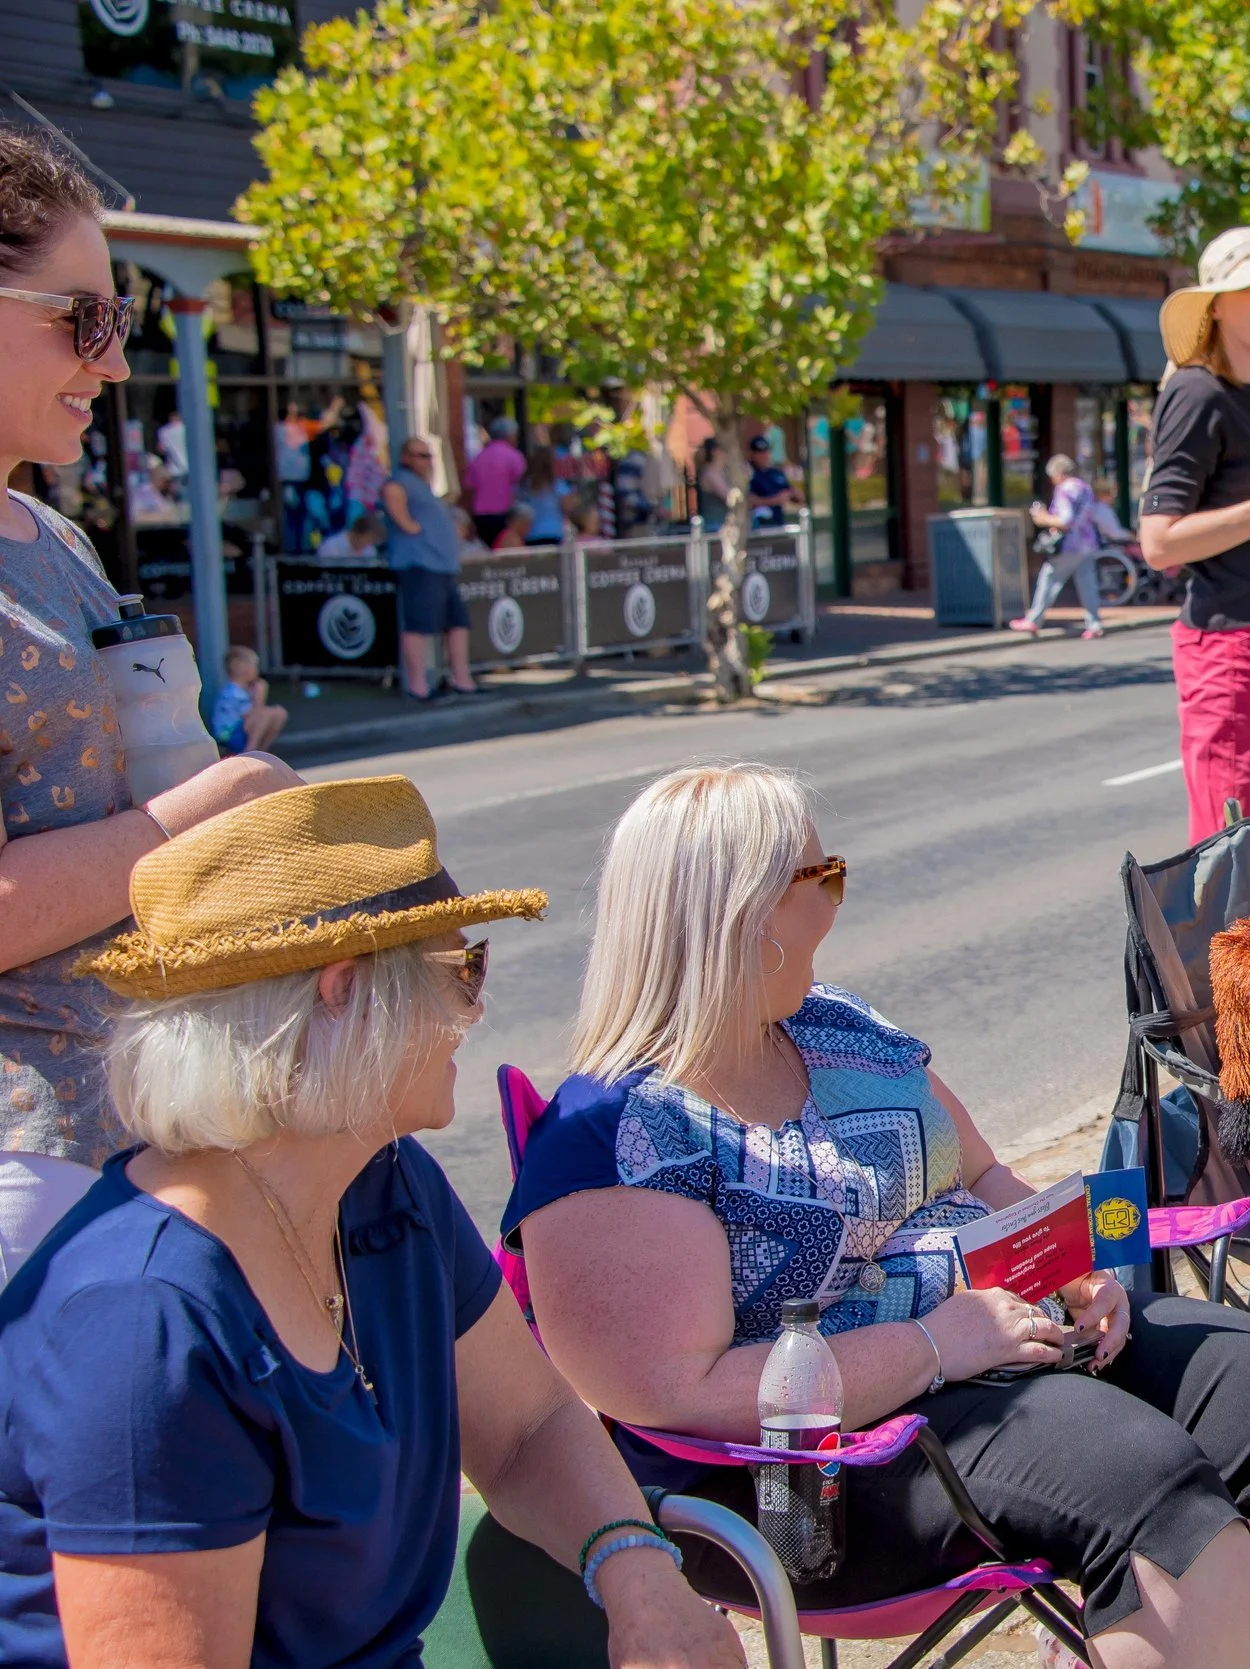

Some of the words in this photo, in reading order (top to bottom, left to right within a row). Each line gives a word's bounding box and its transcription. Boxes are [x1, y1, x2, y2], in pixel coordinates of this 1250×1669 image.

[588, 567, 640, 589] COFFEE
[642, 564, 687, 583] CREMA
[282, 580, 345, 595] COFFEE
[460, 579, 506, 602] OFFEE
[508, 575, 560, 598] CREMA
[1084, 1184, 1092, 1208] CENTRAL
[1037, 1201, 1050, 1214] Bless
[1001, 1219, 1018, 1233] Easter
[1021, 1234, 1032, 1245] you
[1032, 1228, 1043, 1239] give
[1012, 1241, 1022, 1249] life
[1043, 1242, 1057, 1254] Hope
[1033, 1250, 1044, 1261] and
[1010, 1257, 1034, 1273] Freedom
[1003, 1263, 1036, 1284] Forgiveness,
[1020, 1285, 1034, 1296] loves
